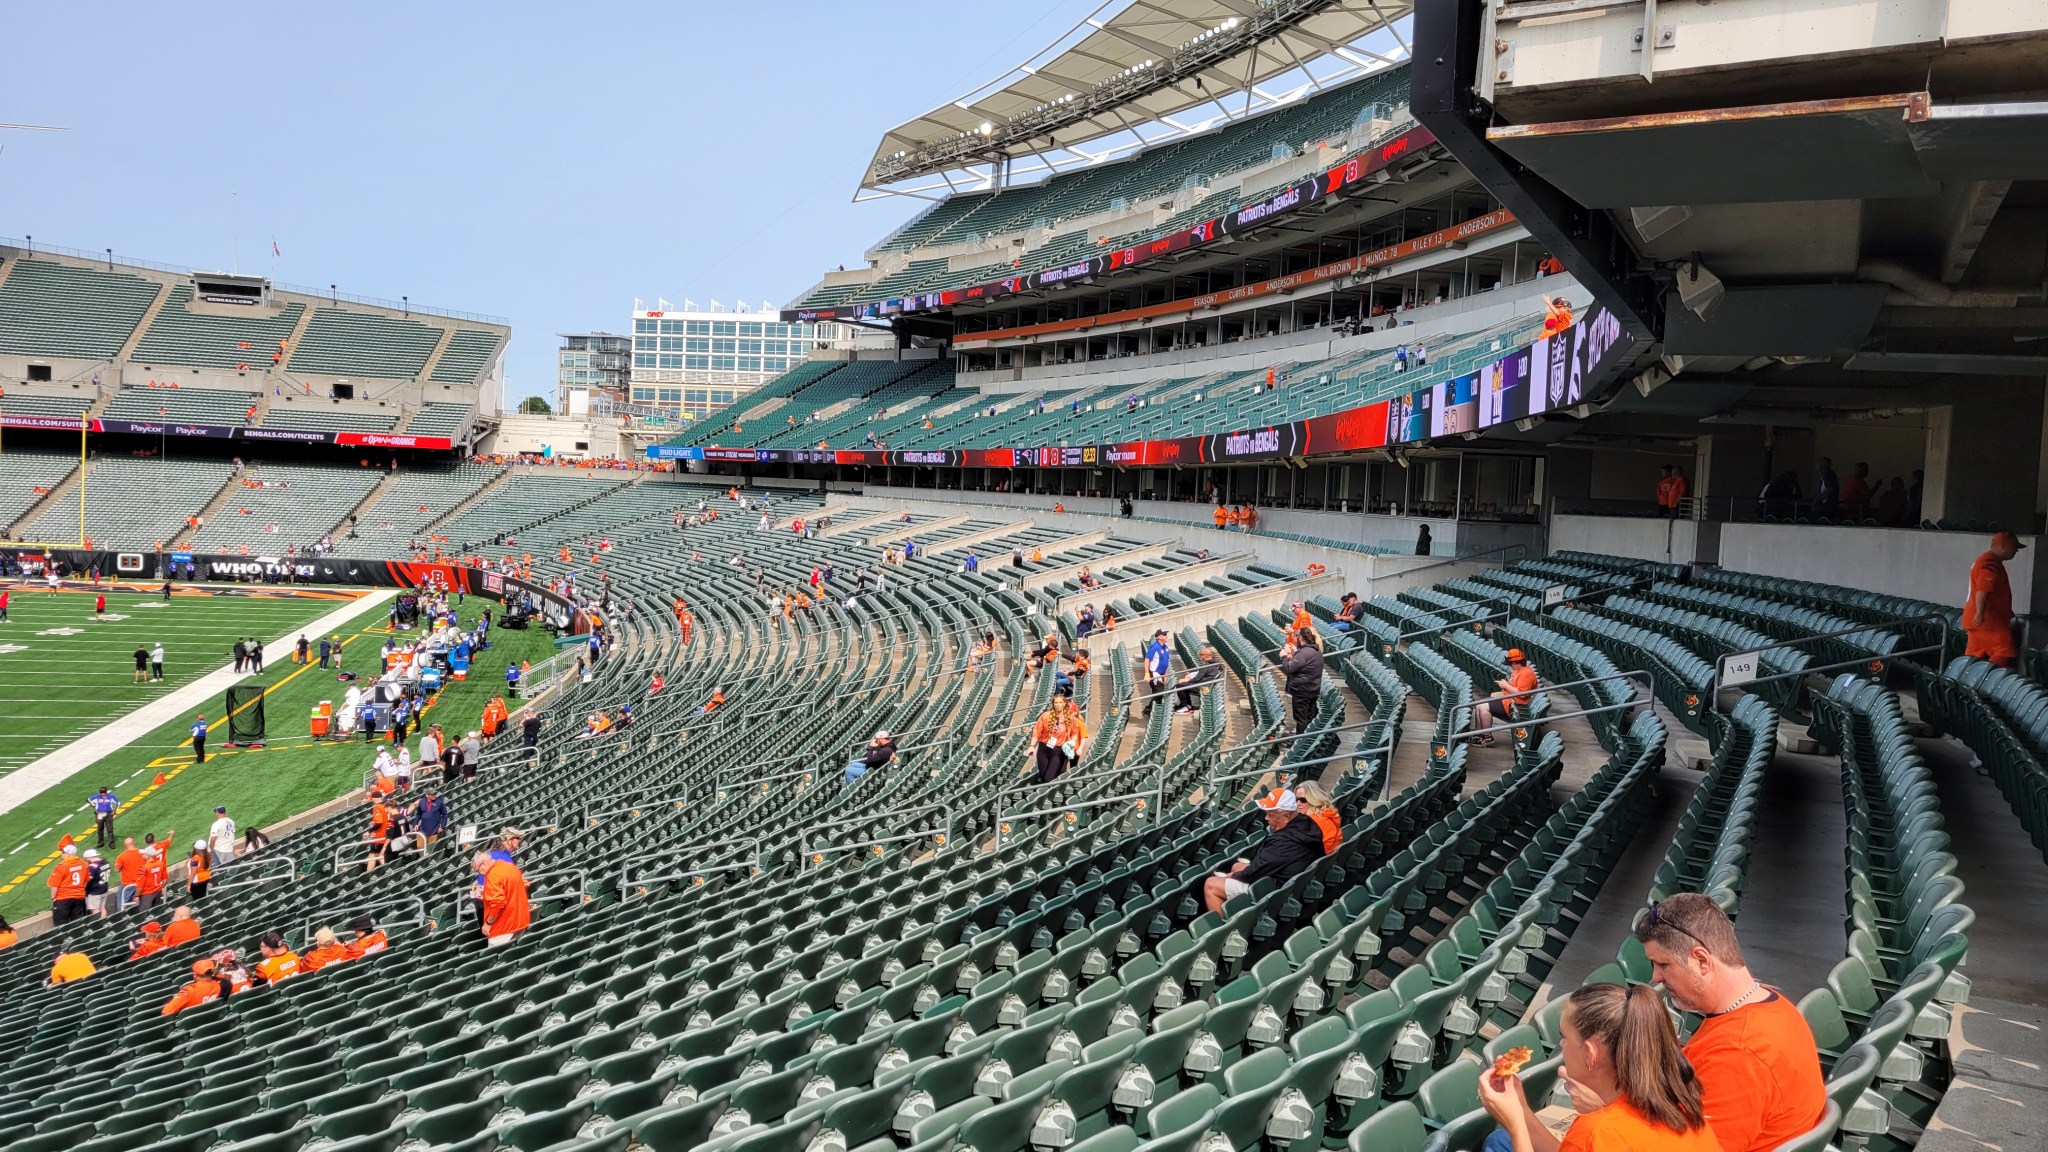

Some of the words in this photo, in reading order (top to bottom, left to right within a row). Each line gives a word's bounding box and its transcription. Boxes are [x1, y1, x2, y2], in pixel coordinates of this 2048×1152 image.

[1237, 203, 1266, 225] PATRIOTS
[1273, 188, 1300, 212] BENGALS
[1457, 216, 1495, 237] ANDERSON
[1497, 211, 1505, 224] 71
[1411, 237, 1432, 251] RILEY
[1434, 233, 1443, 244] 13
[1390, 247, 1398, 258] 78
[1040, 268, 1062, 284] PATRIOTS
[1067, 262, 1090, 277] BENGALS
[1313, 267, 1329, 280] PAUL
[1329, 262, 1351, 276] BROWN
[1265, 278, 1295, 291] ANDERSON
[206, 296, 253, 305] BENGALS.COM
[1228, 289, 1246, 300] CURTIS
[798, 311, 817, 320] Paycor
[130, 424, 164, 434] Paycor
[175, 426, 208, 436] Paycor
[244, 430, 325, 441] BENGALS.COM/TICKETS
[1226, 435, 1250, 456] PATRIOTS
[1254, 430, 1279, 453] BENGALS
[660, 448, 673, 456] BUD
[673, 449, 692, 457] LIGHT
[903, 452, 922, 463] PATRIOTS
[927, 452, 946, 463] BENGALS
[1106, 450, 1122, 463] Paycor
[212, 562, 262, 574] WHO
[1729, 662, 1751, 675] 149
[72, 872, 81, 886] 9
